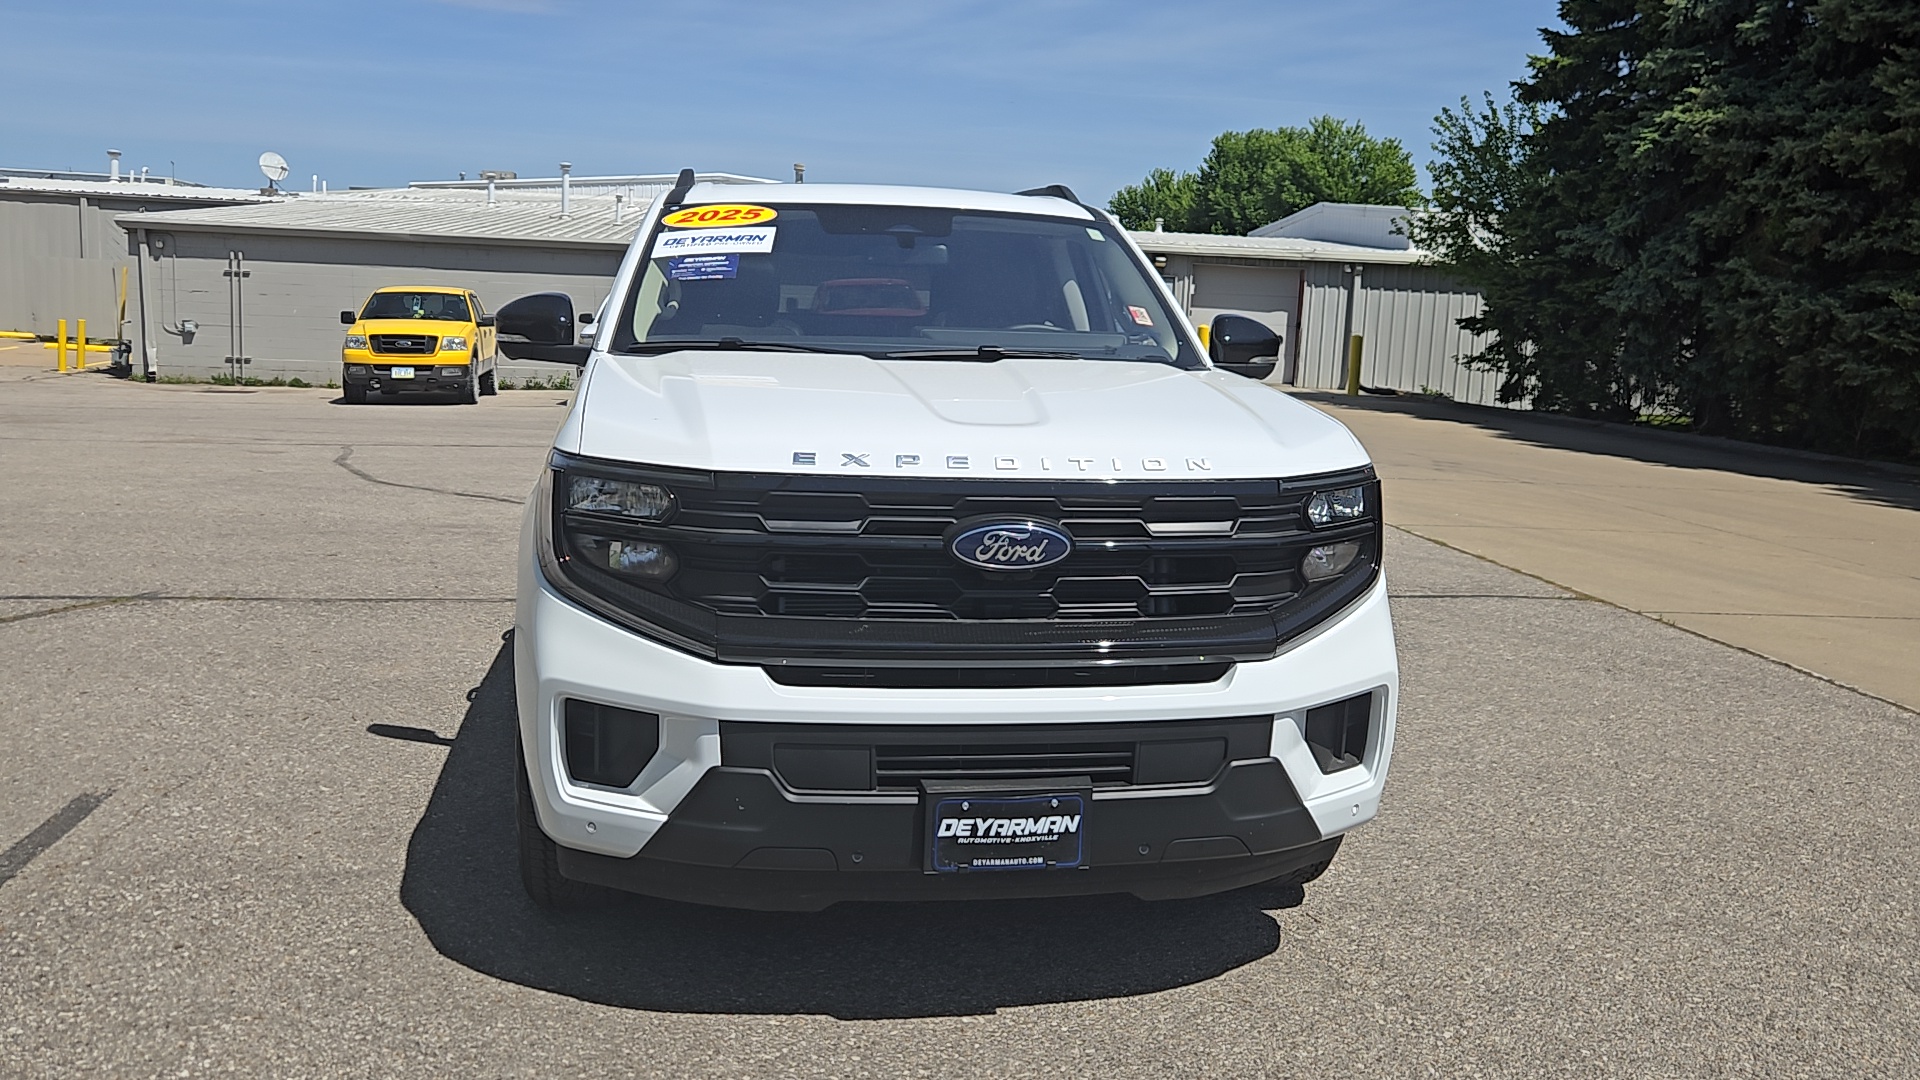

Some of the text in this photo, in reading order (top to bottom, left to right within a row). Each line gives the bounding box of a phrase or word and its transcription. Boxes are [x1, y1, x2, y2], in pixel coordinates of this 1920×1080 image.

[674, 209, 764, 224] 2025
[663, 234, 767, 246] DEYARMAN
[792, 451, 1212, 472] EXPEDITION
[975, 530, 1049, 562] Ford
[937, 815, 1081, 838] DEYARMAN
[972, 857, 1044, 867] DEYARMANAUTO.COM
